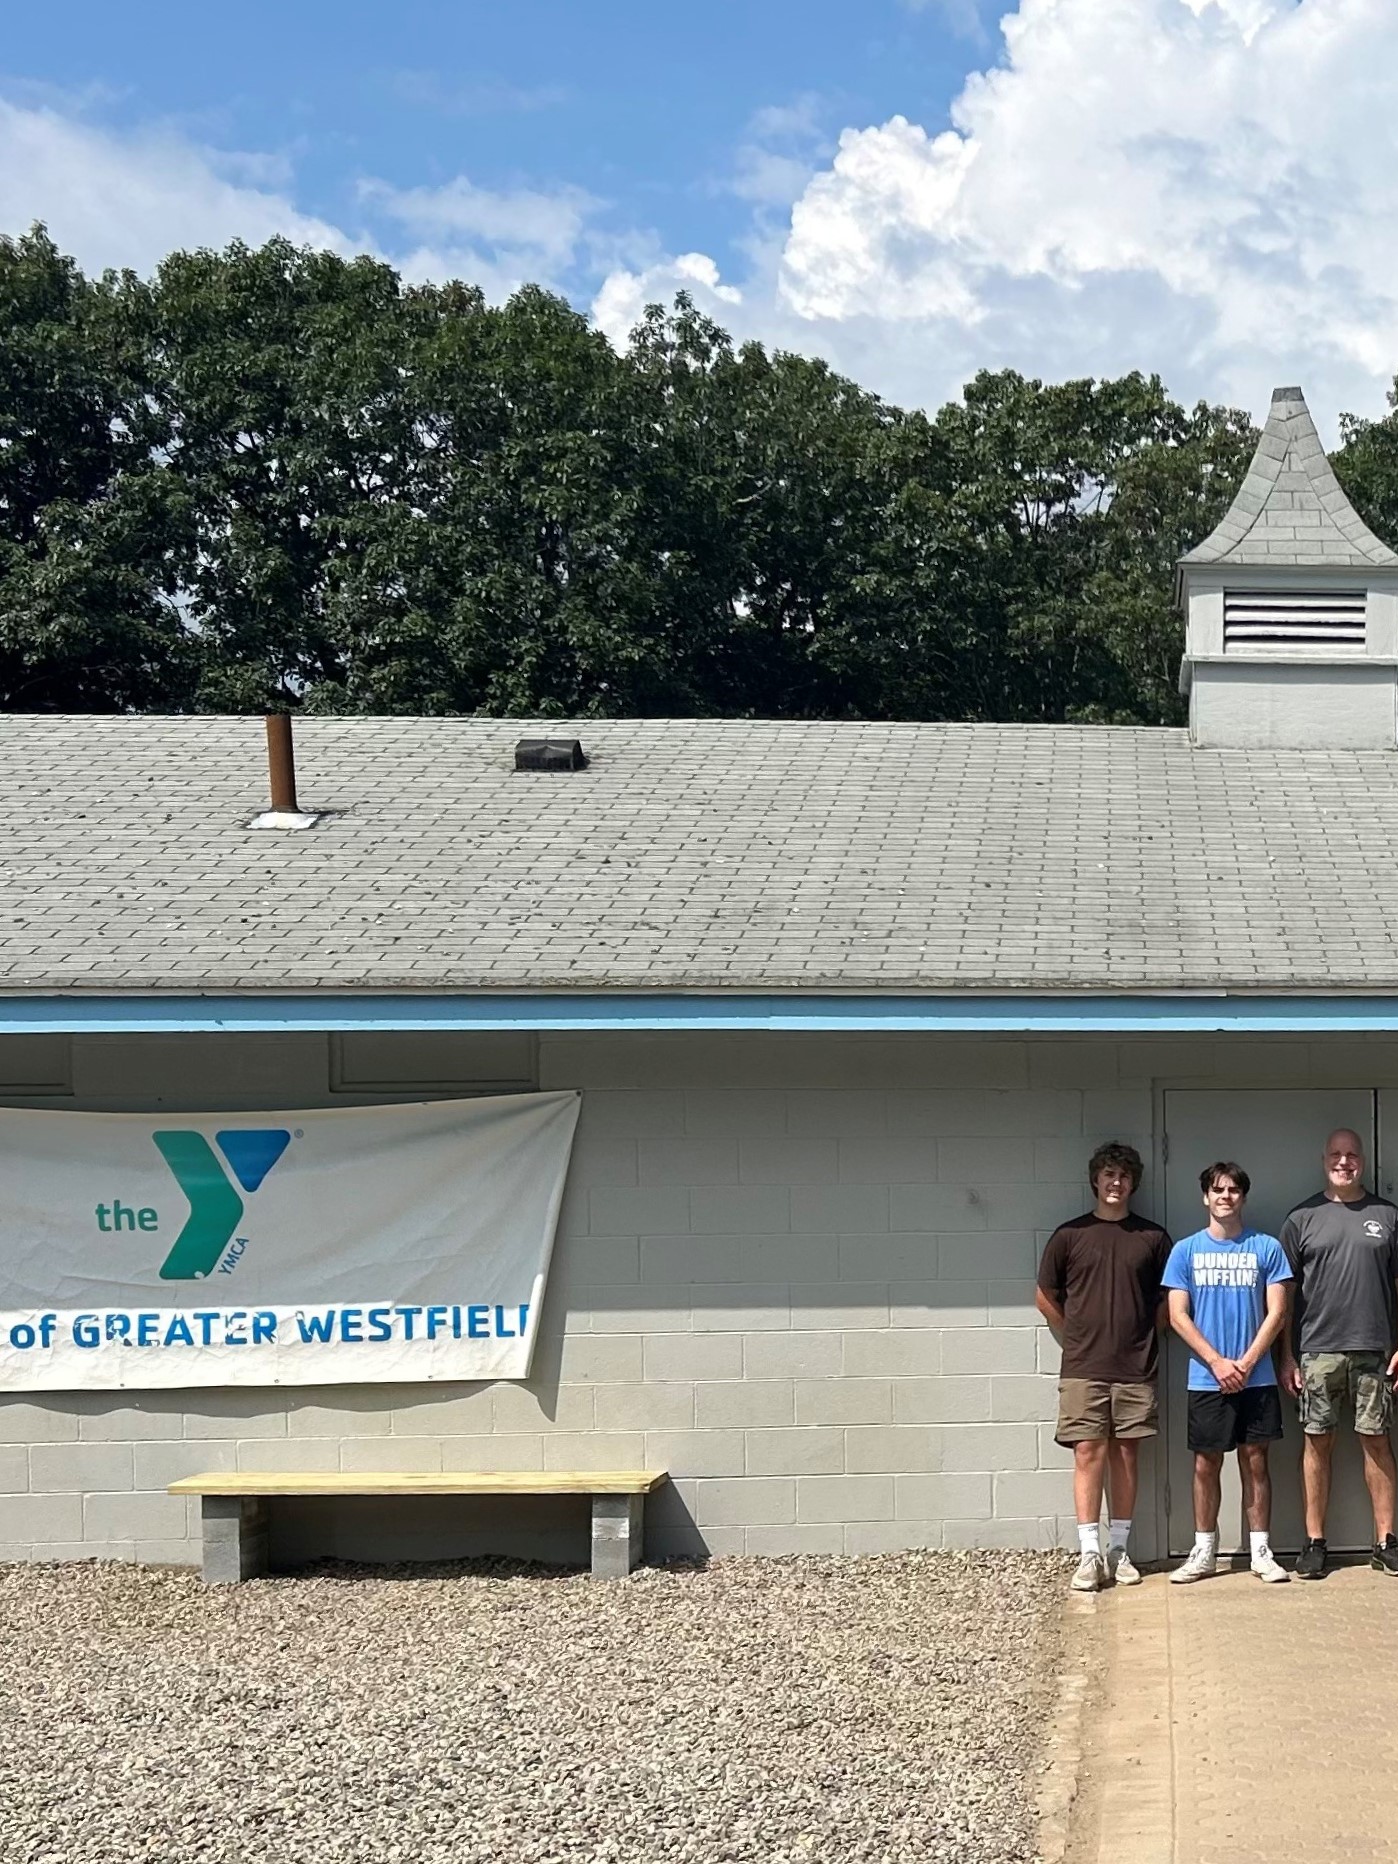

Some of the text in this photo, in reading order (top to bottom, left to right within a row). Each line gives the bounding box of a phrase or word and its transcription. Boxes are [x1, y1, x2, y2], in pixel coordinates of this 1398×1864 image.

[95, 1199, 158, 1232] the
[217, 1237, 250, 1276] YMCA
[1193, 1252, 1257, 1269] DUNDER
[9, 1313, 57, 1349] of
[72, 1311, 278, 1349] GREATER
